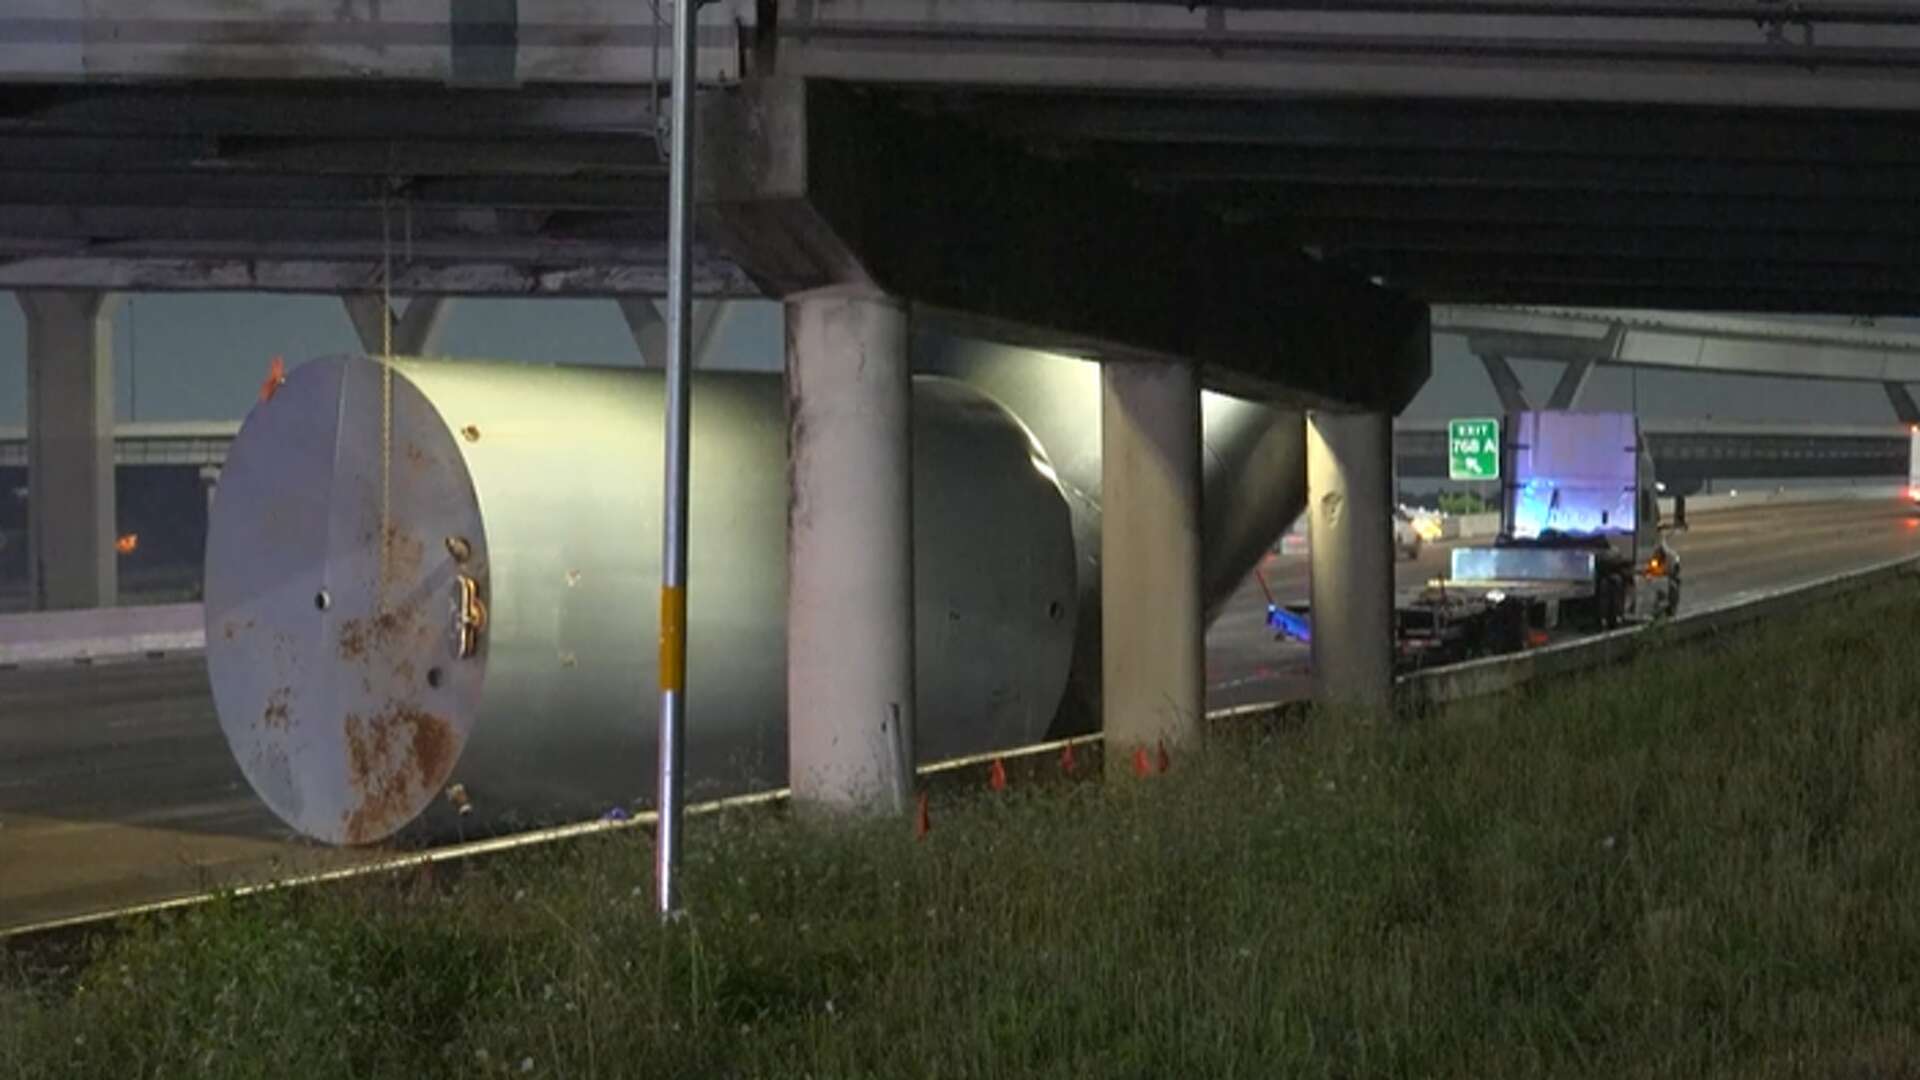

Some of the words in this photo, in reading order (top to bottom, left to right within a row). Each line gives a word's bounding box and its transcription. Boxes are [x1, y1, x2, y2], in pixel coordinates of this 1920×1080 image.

[1458, 425, 1488, 436] EXIT
[1453, 438, 1480, 454] 768
[1484, 438, 1496, 454] A
